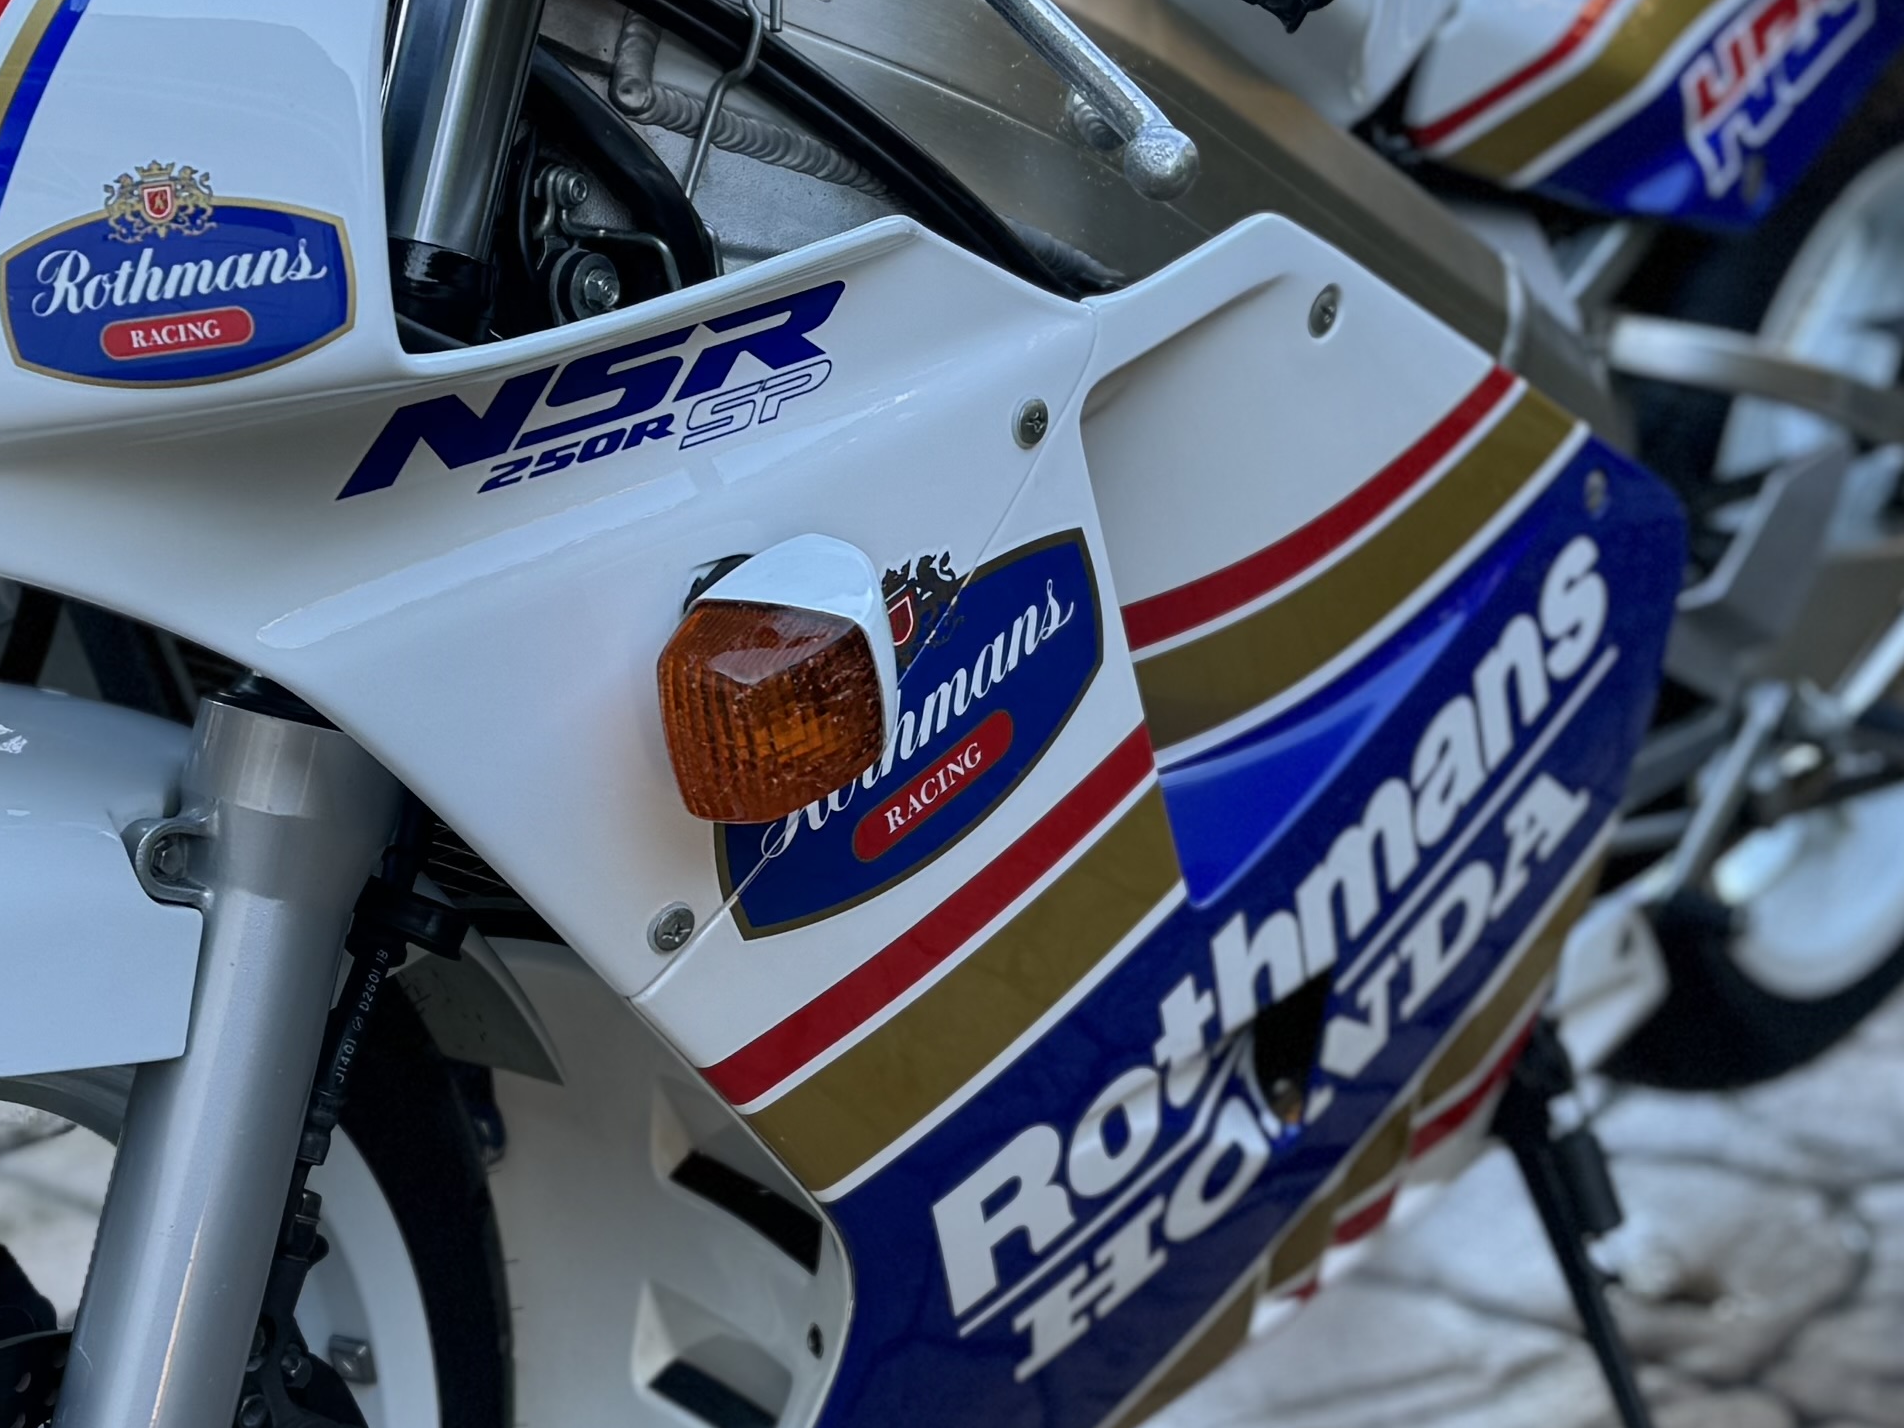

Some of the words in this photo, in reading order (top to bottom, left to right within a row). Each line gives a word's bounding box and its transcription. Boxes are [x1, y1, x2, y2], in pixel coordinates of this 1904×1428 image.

[32, 238, 328, 317] Rothmans
[130, 319, 222, 349] RACING
[335, 280, 846, 501] NSR
[476, 413, 675, 494] 250R
[678, 359, 834, 451] SP
[883, 742, 984, 835] RACING
[931, 534, 1610, 1317] Rothmans
